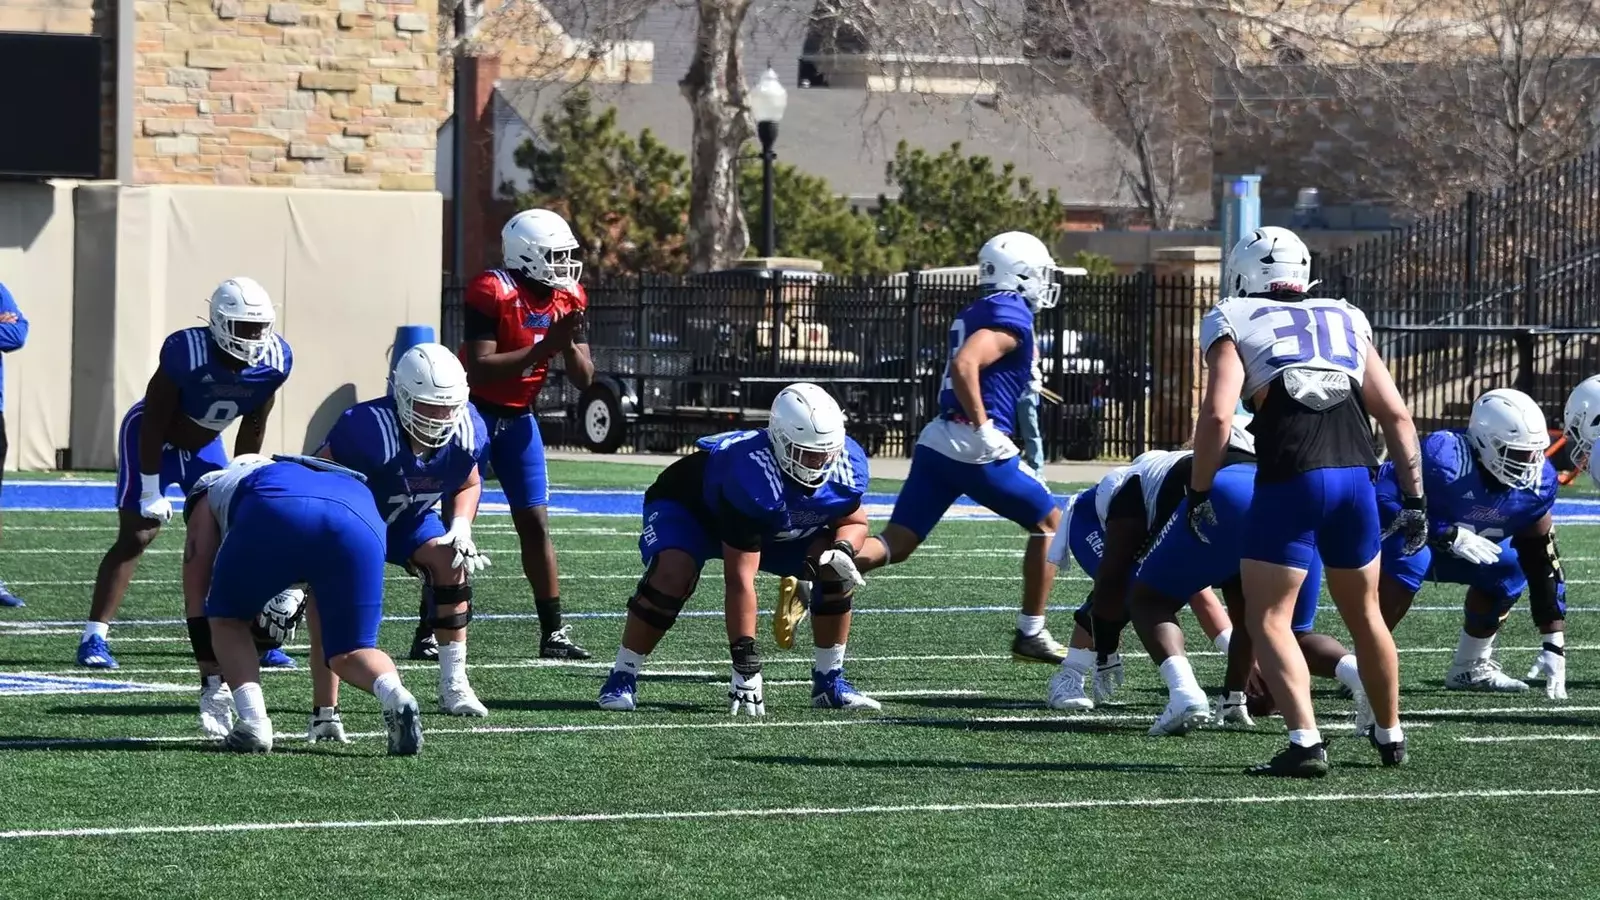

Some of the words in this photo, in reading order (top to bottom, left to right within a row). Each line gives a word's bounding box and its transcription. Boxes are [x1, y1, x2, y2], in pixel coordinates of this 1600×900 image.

[1249, 306, 1360, 371] 30
[198, 400, 239, 432] 0
[386, 492, 444, 526] 77
